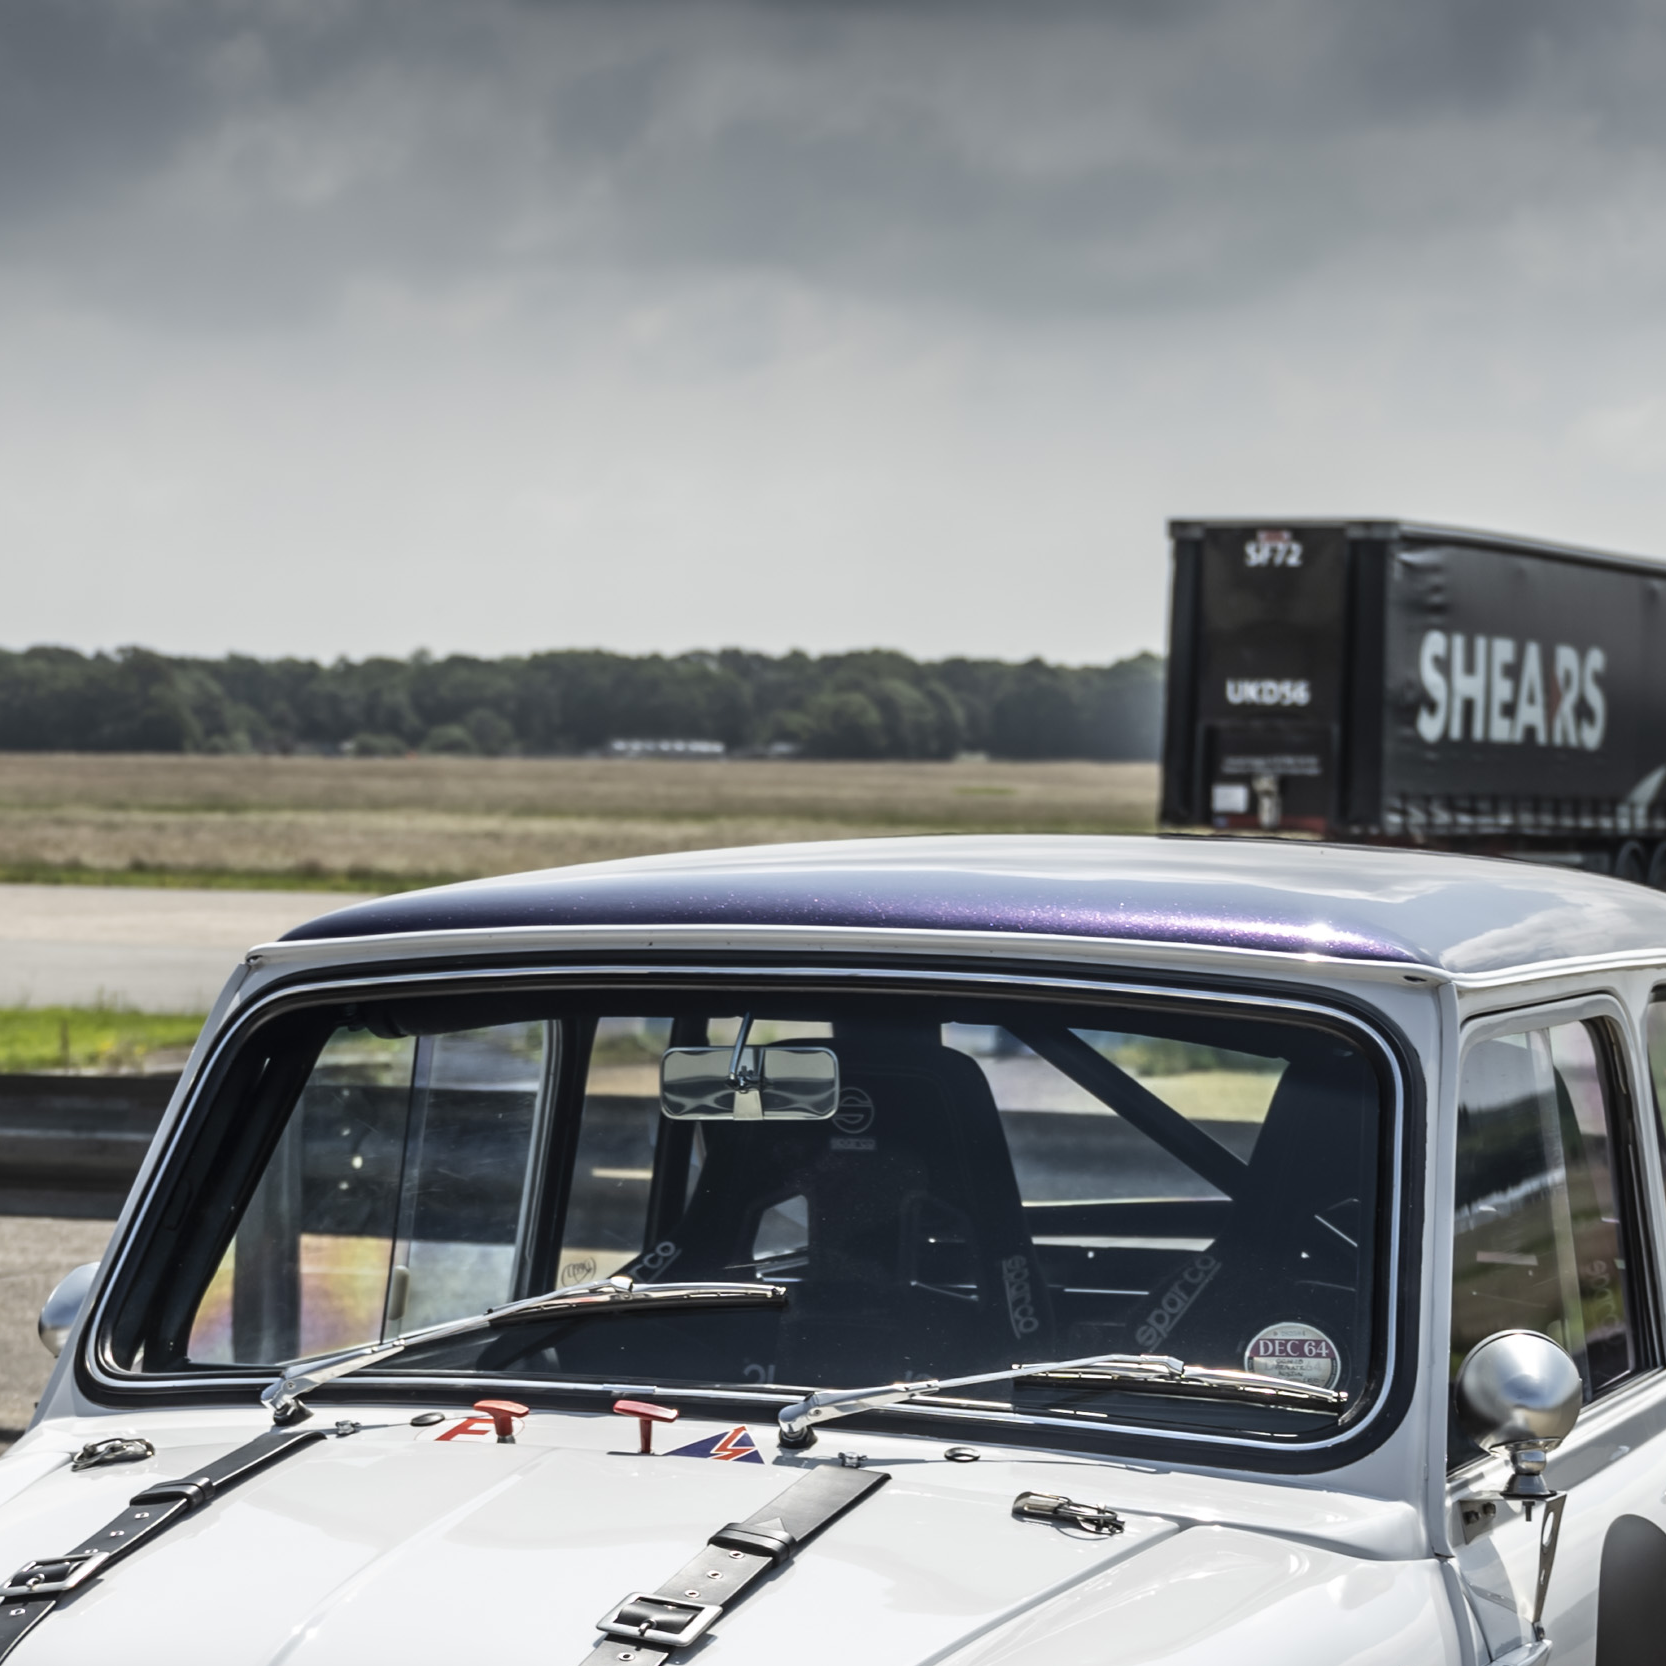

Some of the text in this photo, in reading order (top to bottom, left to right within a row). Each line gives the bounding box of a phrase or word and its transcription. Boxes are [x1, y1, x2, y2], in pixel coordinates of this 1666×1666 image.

[1244, 541, 1303, 567] SF72
[1226, 679, 1311, 706] UKD56
[1417, 630, 1606, 751] SHEARS
[1134, 1255, 1218, 1348] sparco
[1258, 1339, 1329, 1357] DEC 64
